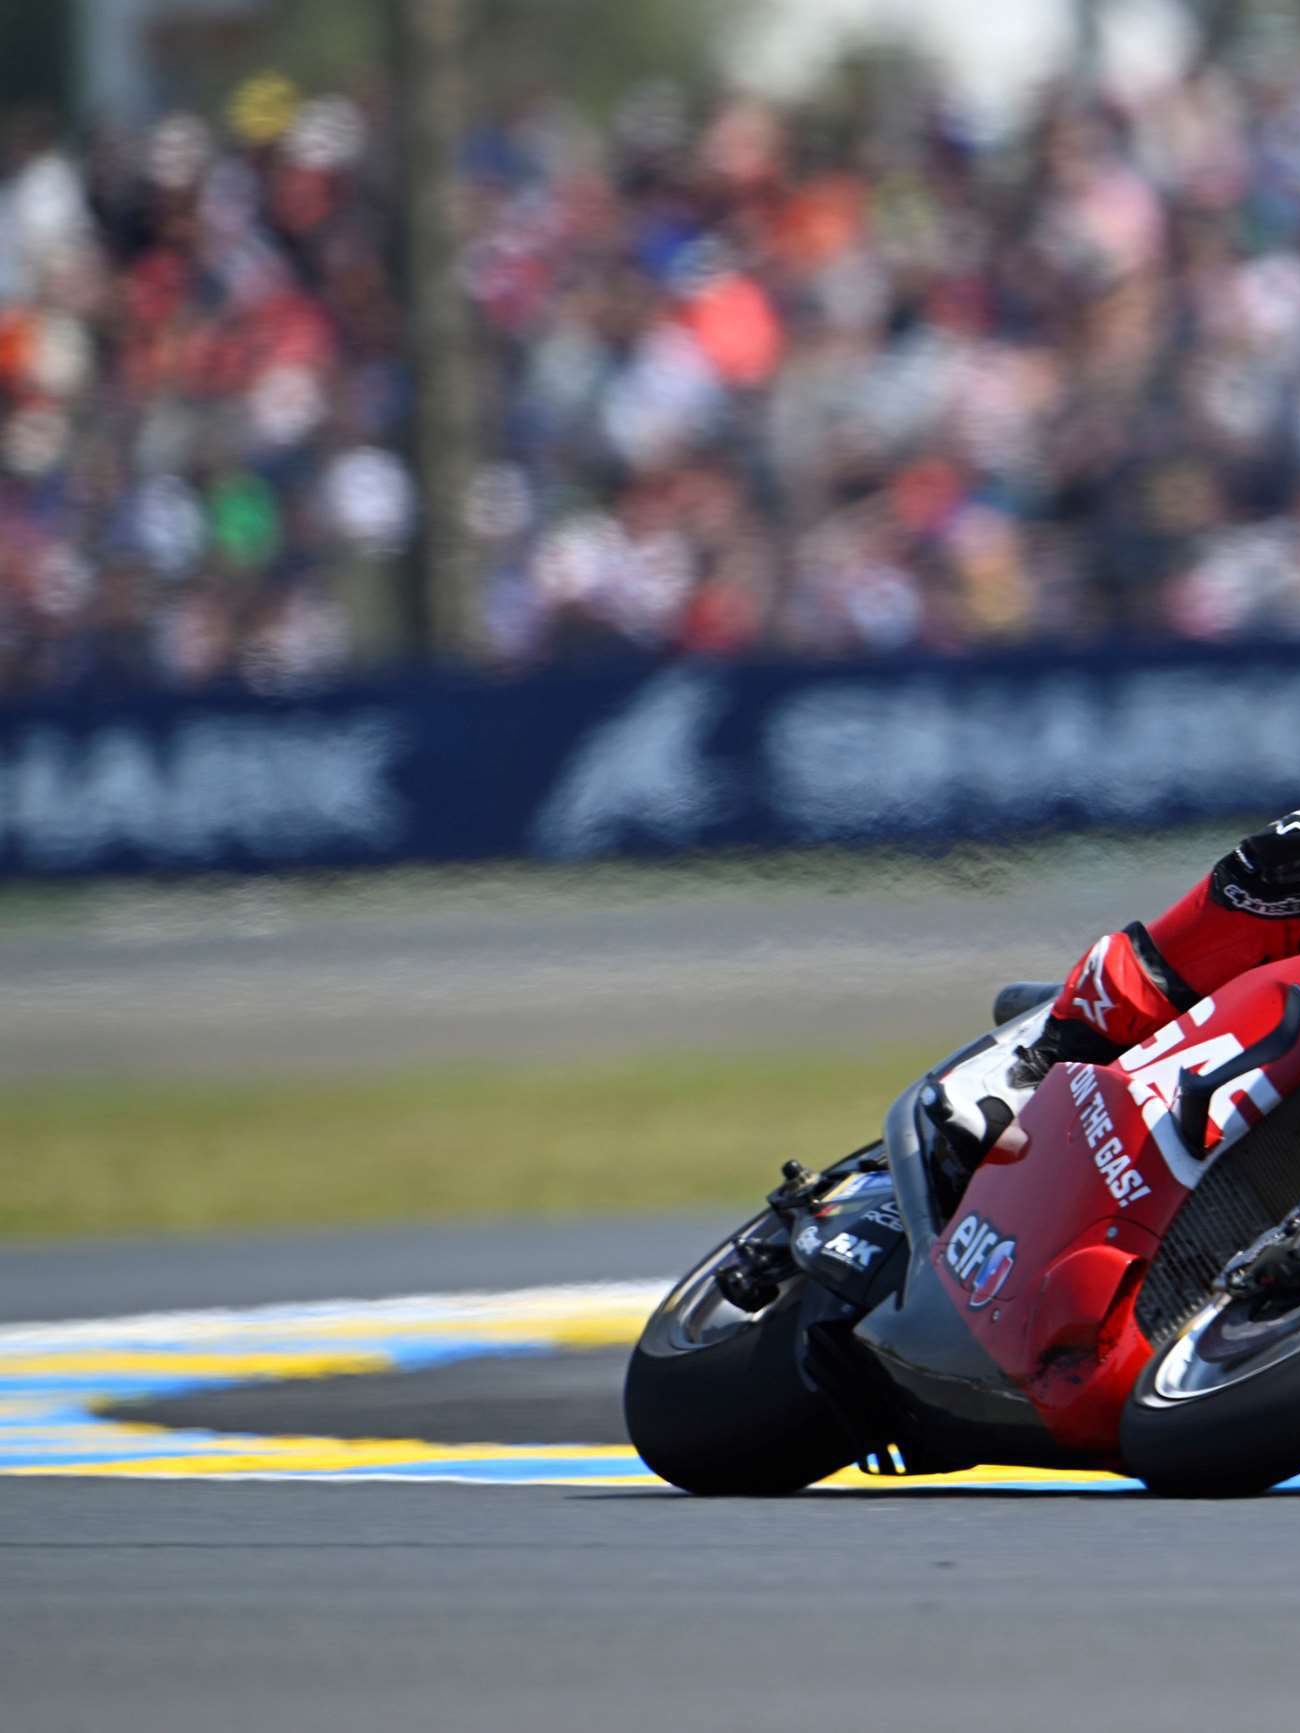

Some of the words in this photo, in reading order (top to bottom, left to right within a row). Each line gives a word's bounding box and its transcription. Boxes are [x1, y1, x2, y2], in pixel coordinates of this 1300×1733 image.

[1069, 1064, 1098, 1106] ON
[1080, 1091, 1114, 1148] THE
[1094, 1136, 1152, 1208] GAS!
[945, 1214, 1001, 1281] elf
